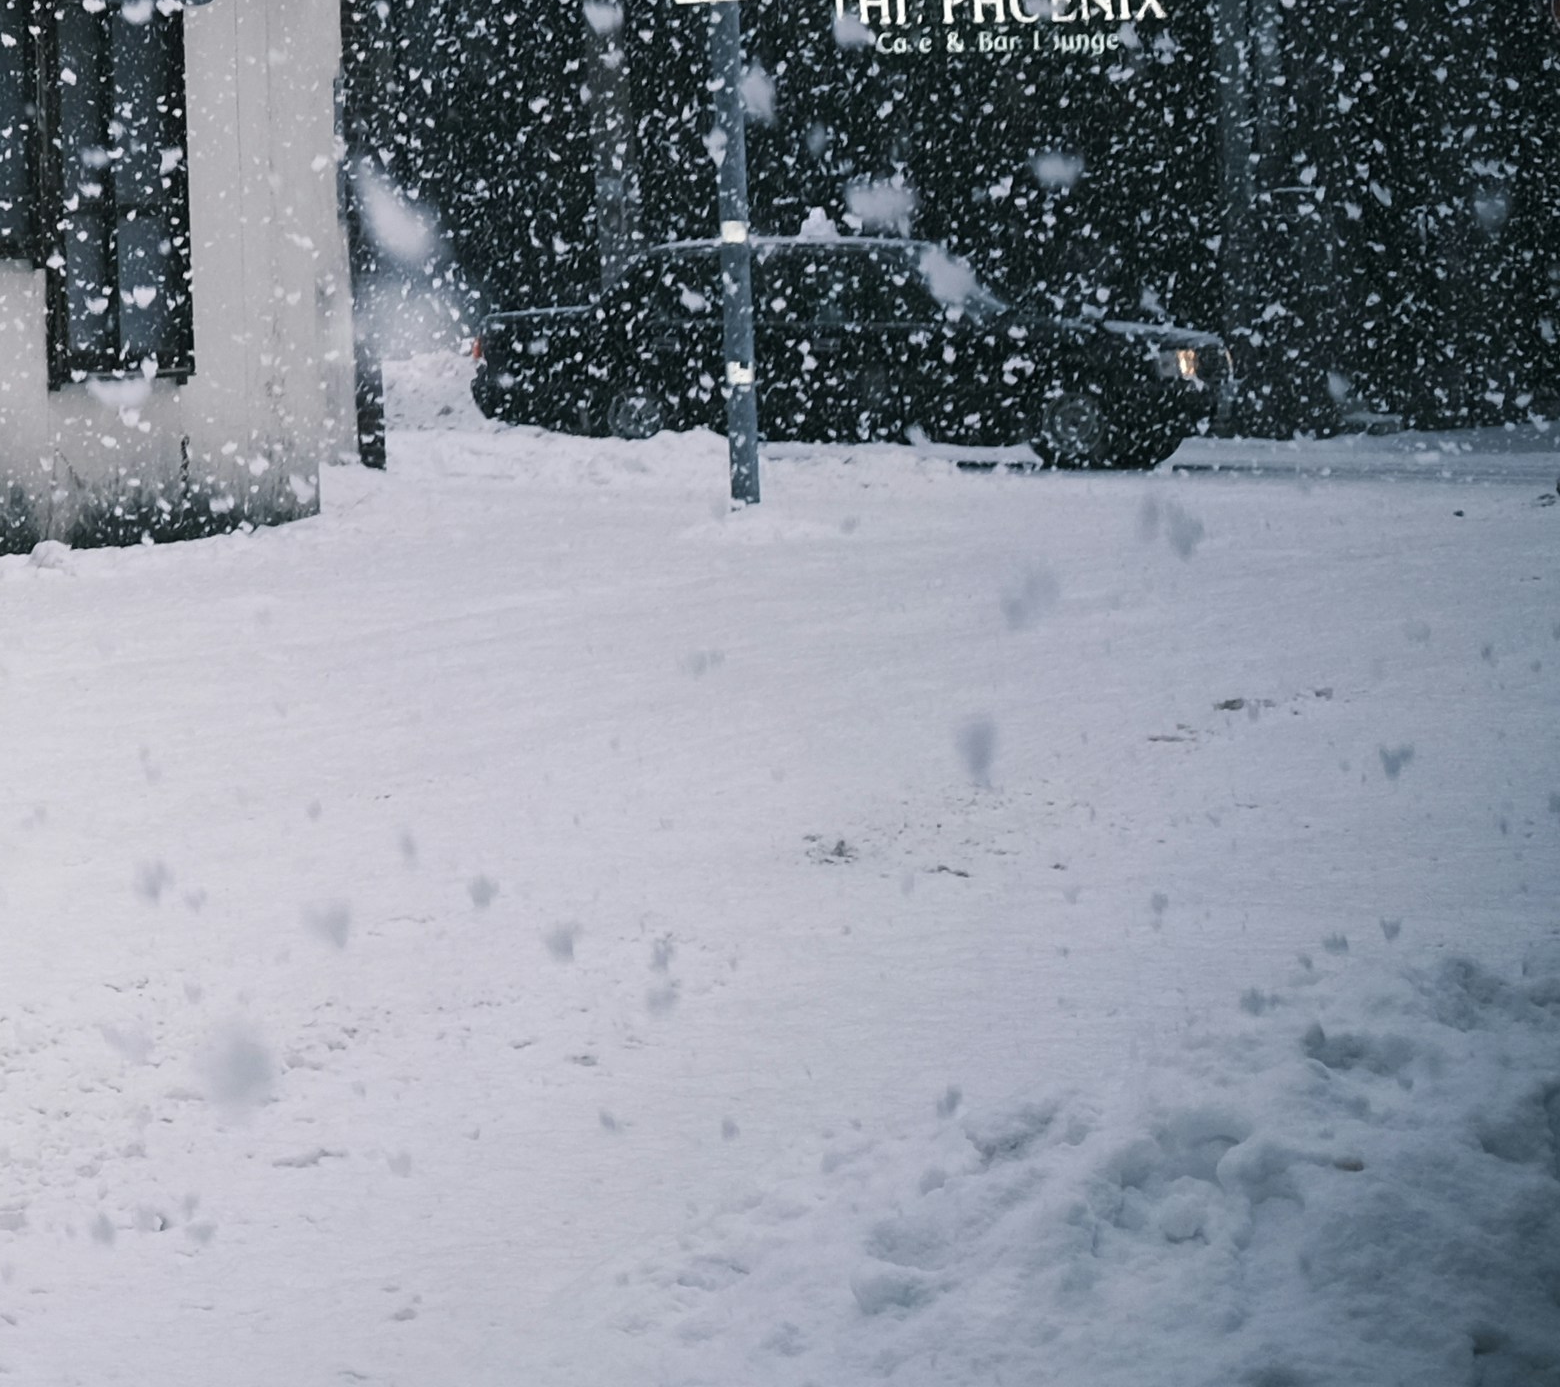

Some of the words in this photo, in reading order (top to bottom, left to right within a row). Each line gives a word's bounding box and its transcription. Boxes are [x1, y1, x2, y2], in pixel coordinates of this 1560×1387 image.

[876, 31, 932, 55] Cae
[947, 31, 964, 53] &
[978, 30, 1020, 54] Bar
